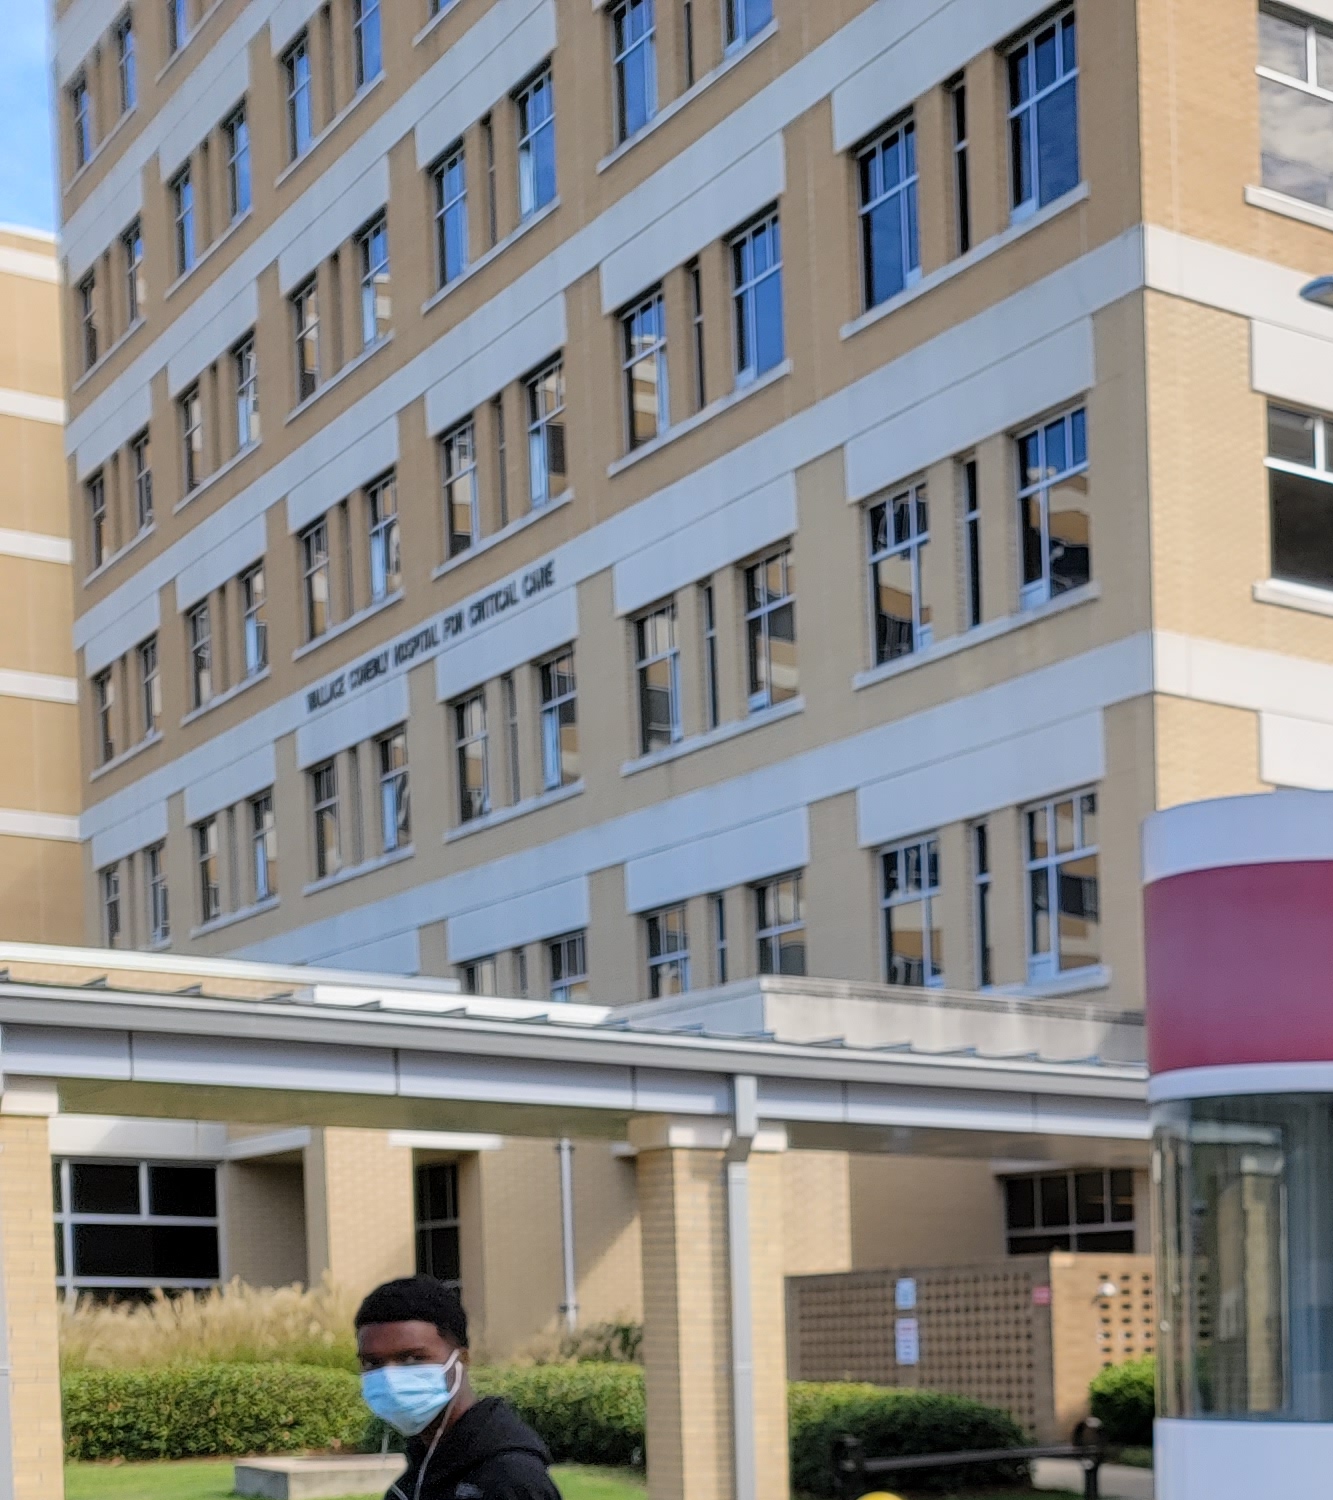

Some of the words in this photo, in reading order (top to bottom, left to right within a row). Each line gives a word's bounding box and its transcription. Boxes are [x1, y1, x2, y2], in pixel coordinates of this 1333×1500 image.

[394, 624, 440, 669] HOSPITAL
[443, 612, 465, 640] FOR
[469, 579, 518, 628] CRITICAL
[522, 559, 555, 598] CARE
